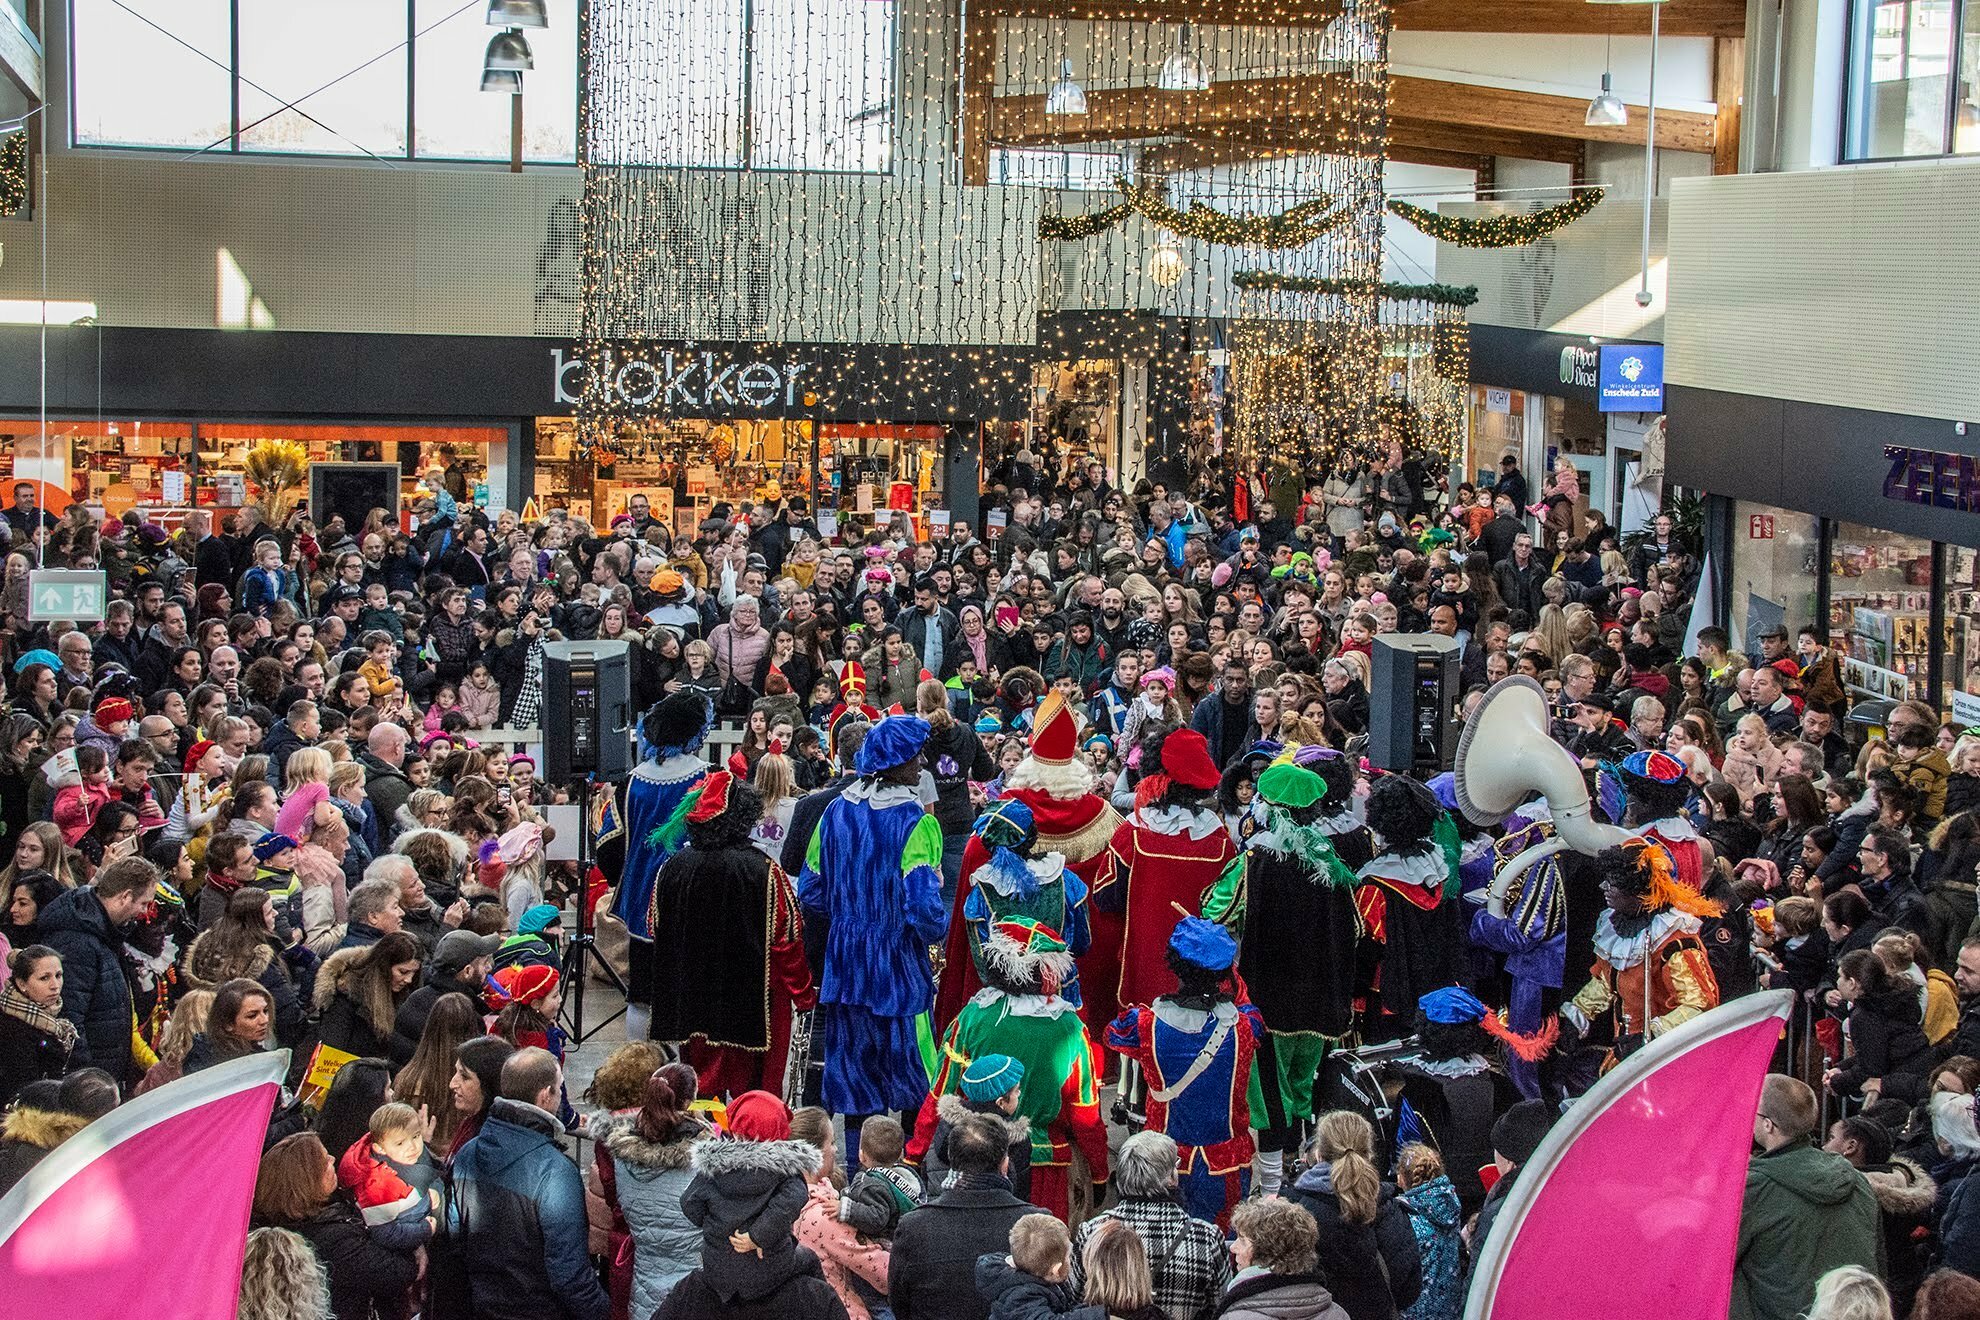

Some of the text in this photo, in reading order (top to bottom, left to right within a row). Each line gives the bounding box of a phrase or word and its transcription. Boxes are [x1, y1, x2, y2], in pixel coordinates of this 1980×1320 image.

[1603, 388, 1660, 397] Enschede Zuid
[1488, 390, 1509, 405] VICHY
[323, 1060, 343, 1068] Welko
[315, 1066, 330, 1074] Sint
